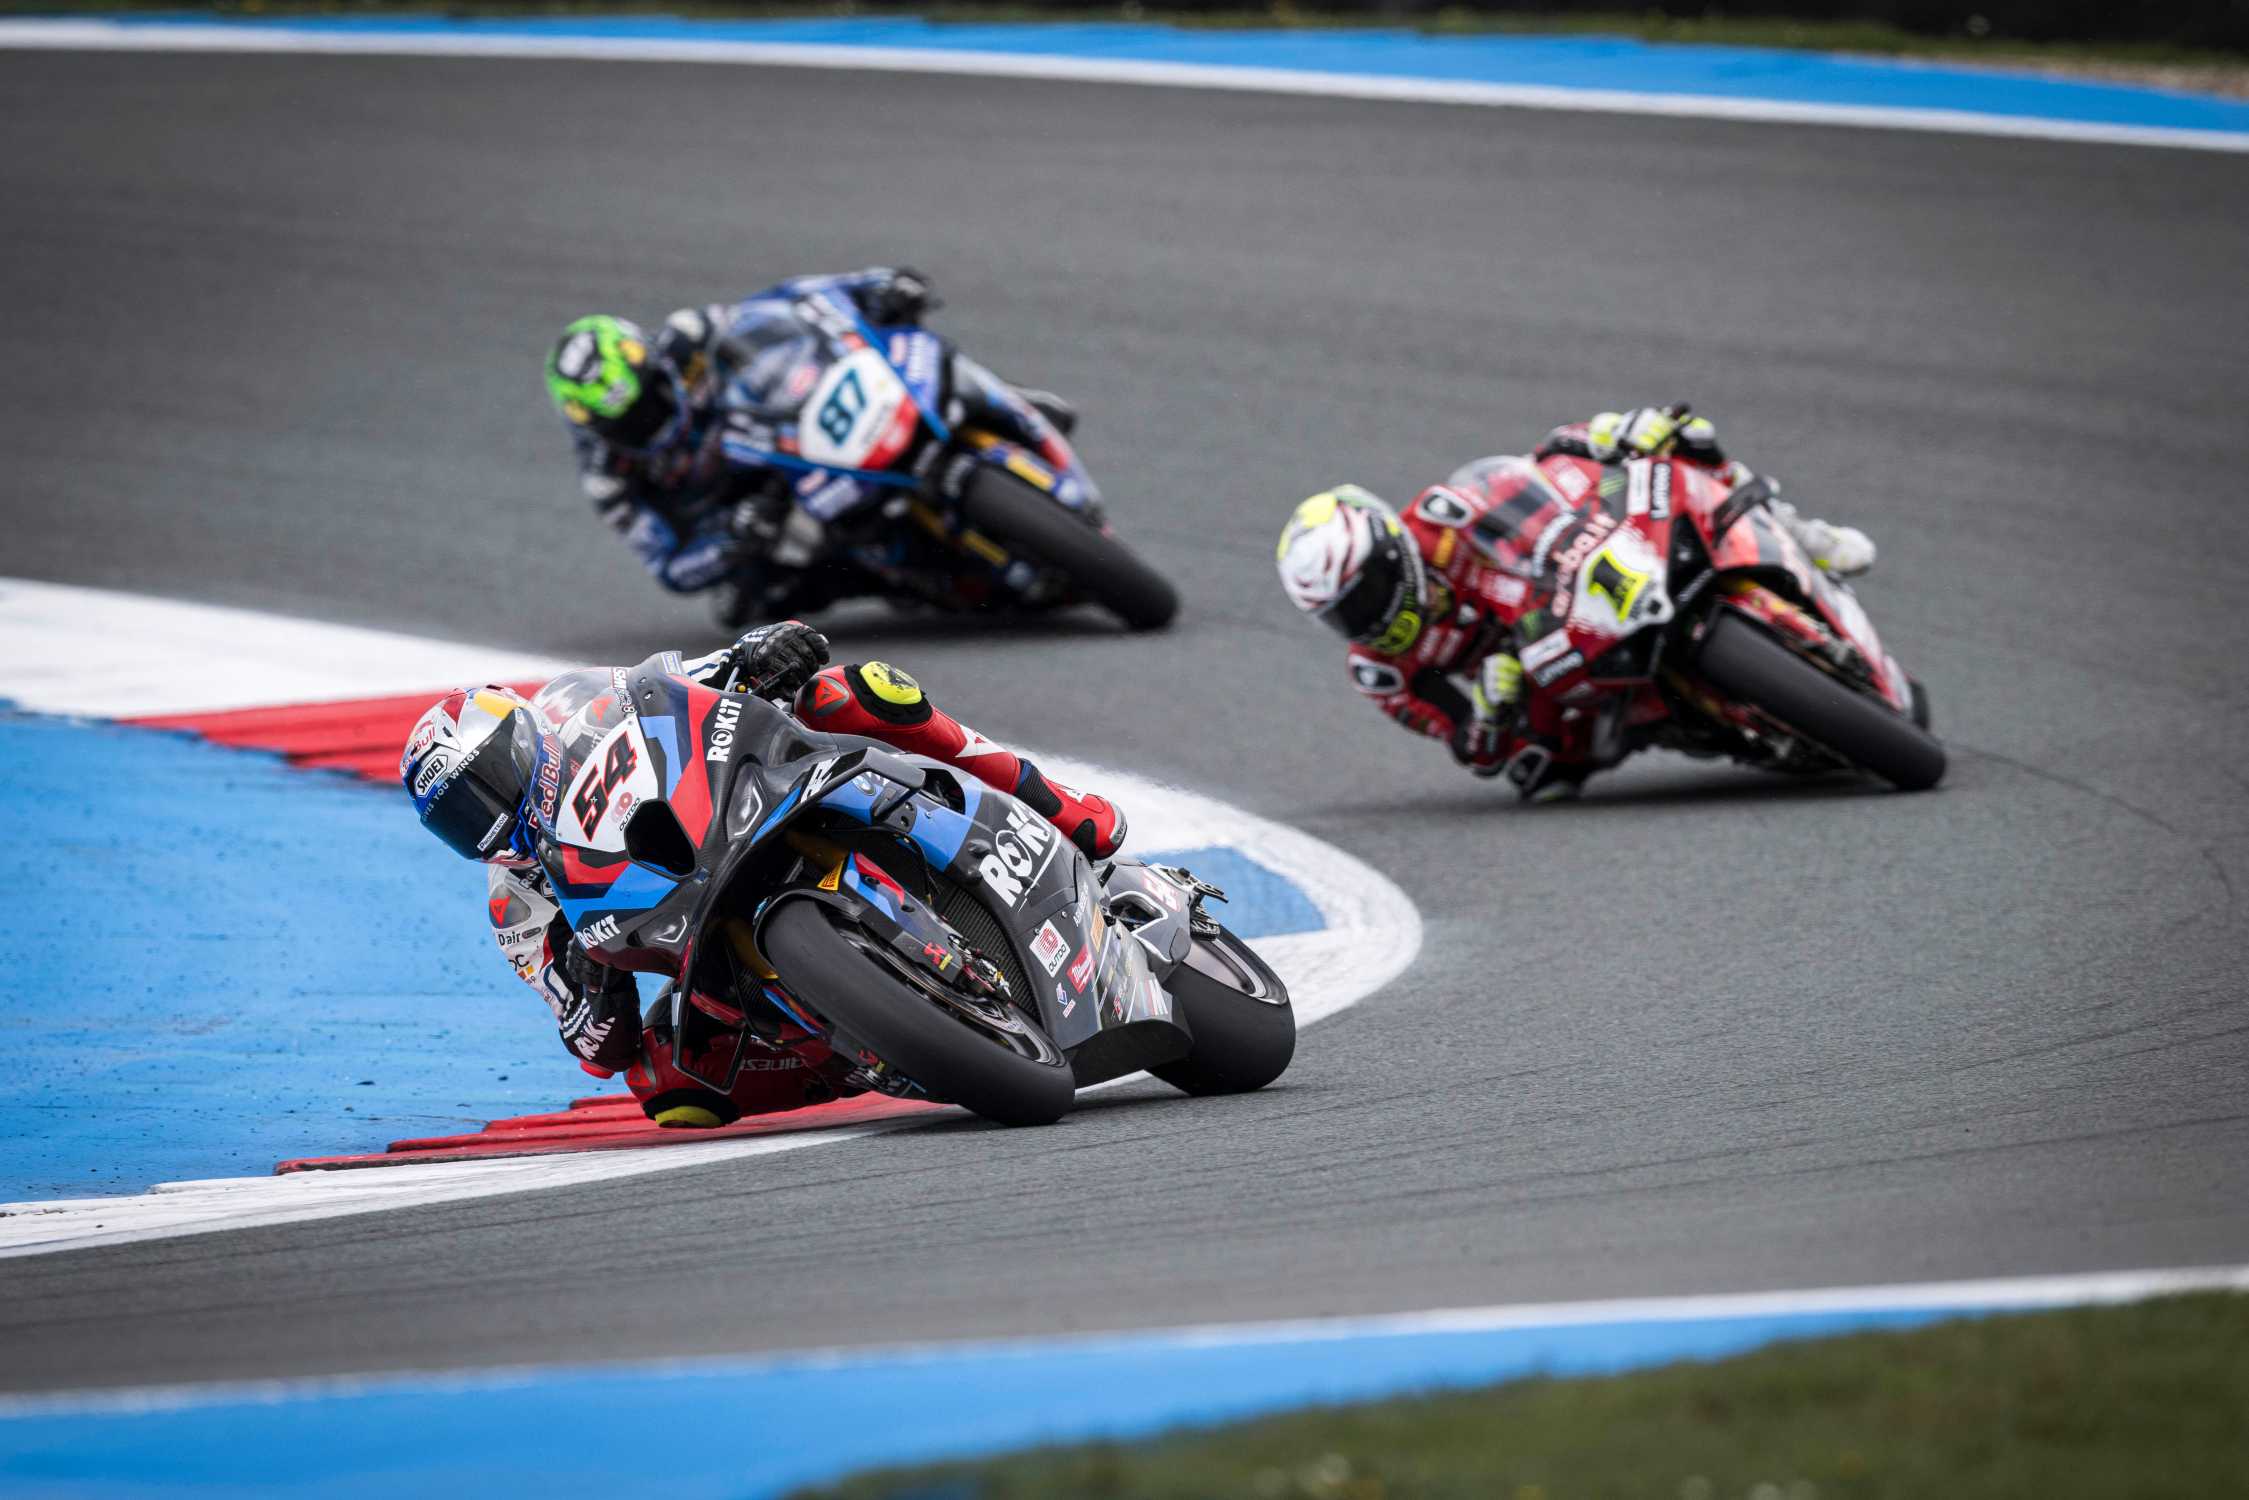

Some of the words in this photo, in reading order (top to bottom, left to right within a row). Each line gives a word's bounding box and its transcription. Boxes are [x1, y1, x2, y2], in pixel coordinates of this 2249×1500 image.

[817, 369, 867, 446] 87
[415, 757, 445, 794] SHOEI
[434, 783, 449, 801] YOU
[450, 750, 480, 780] WINGS
[572, 730, 638, 842] 54
